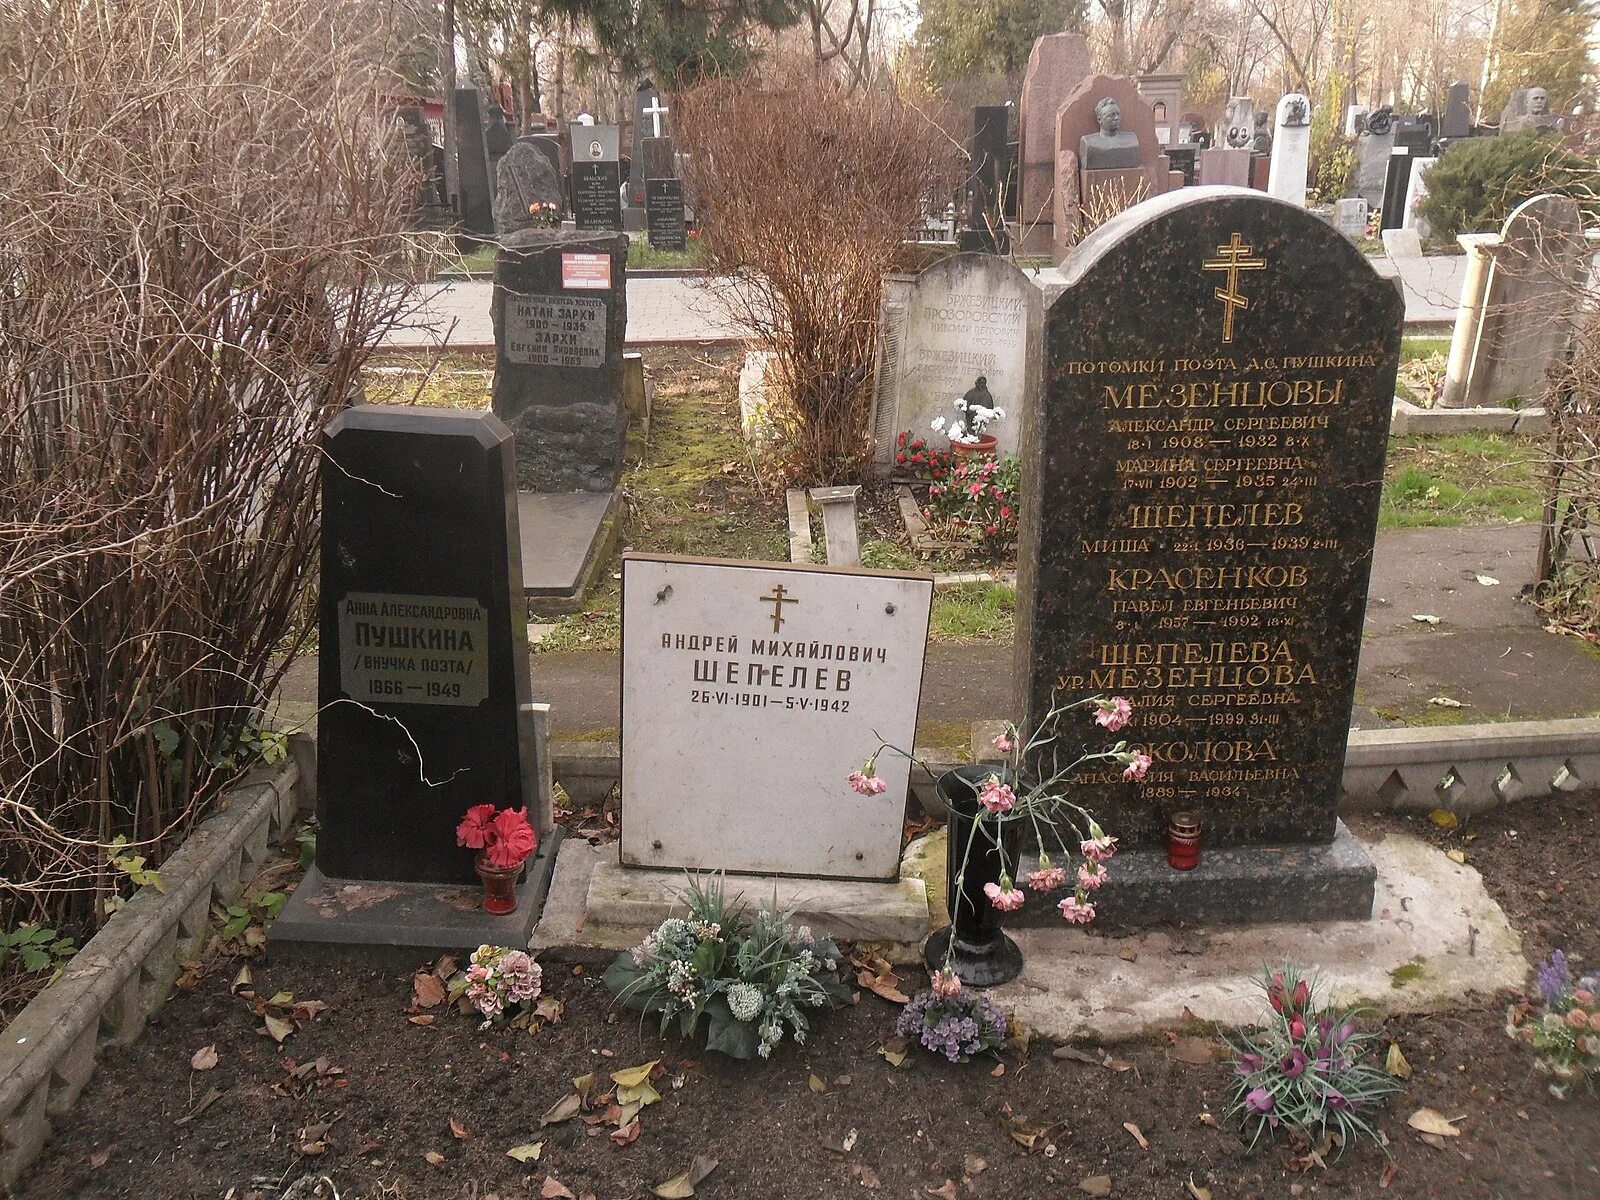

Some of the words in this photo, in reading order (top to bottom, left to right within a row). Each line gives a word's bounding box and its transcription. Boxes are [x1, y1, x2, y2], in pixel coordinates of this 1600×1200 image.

[517, 305, 553, 318] НАТАН
[558, 308, 595, 321] ЗАРХИ
[535, 332, 577, 345] ЗАРХИ
[1068, 360, 1165, 374] ПОТОМКИ
[1174, 357, 1236, 371] ПОЭТА
[1246, 357, 1278, 370] А.С.
[1283, 355, 1376, 369] ПУШКИНА
[1103, 379, 1344, 411] МЕЗЕНЦОВЫ
[1108, 418, 1215, 433] АЛЕКСАНДР
[1224, 415, 1329, 430] СЕРГЕЕВИЧ
[1162, 436, 1204, 449] 1908
[1239, 434, 1278, 448] 1932
[1115, 459, 1197, 473] МАРИНА
[1204, 456, 1303, 471] СЕРГЕЕВНА
[1160, 476, 1198, 489] 1902
[1236, 475, 1275, 488] 1935
[1130, 503, 1303, 529] ШЕПЕЛЕВ
[1081, 538, 1150, 553] МИША
[1206, 538, 1245, 551] 1936
[1272, 537, 1309, 550] 1939
[1107, 566, 1308, 591] КРАСЕНКОВ
[1113, 599, 1173, 613] ПАВЕЛ
[1183, 597, 1298, 611] ЕВГЕНЬЕВИЧ
[1158, 616, 1190, 629] 1957
[1220, 615, 1259, 628] 1992
[355, 623, 474, 651] ПУШКИНА
[661, 633, 738, 653] АНДРЕЙ
[751, 639, 887, 663] МИХАЙЛОВИЧ
[1100, 639, 1294, 666] ШЕПЕЛЕВА
[693, 659, 851, 692] ШЕПЕЛЕВ
[1089, 663, 1319, 690] МЕЗЕНЦОВА
[369, 679, 403, 694] 1866
[427, 682, 461, 698] 1949
[1085, 694, 1175, 708] АЛИЯ
[1188, 692, 1298, 707] СЕРГЕЕВНА
[1142, 713, 1181, 727] 1904
[1209, 713, 1244, 726] 1999
[1189, 768, 1300, 782] ВАСИЛЬЕВНА
[1141, 787, 1175, 798] 1889
